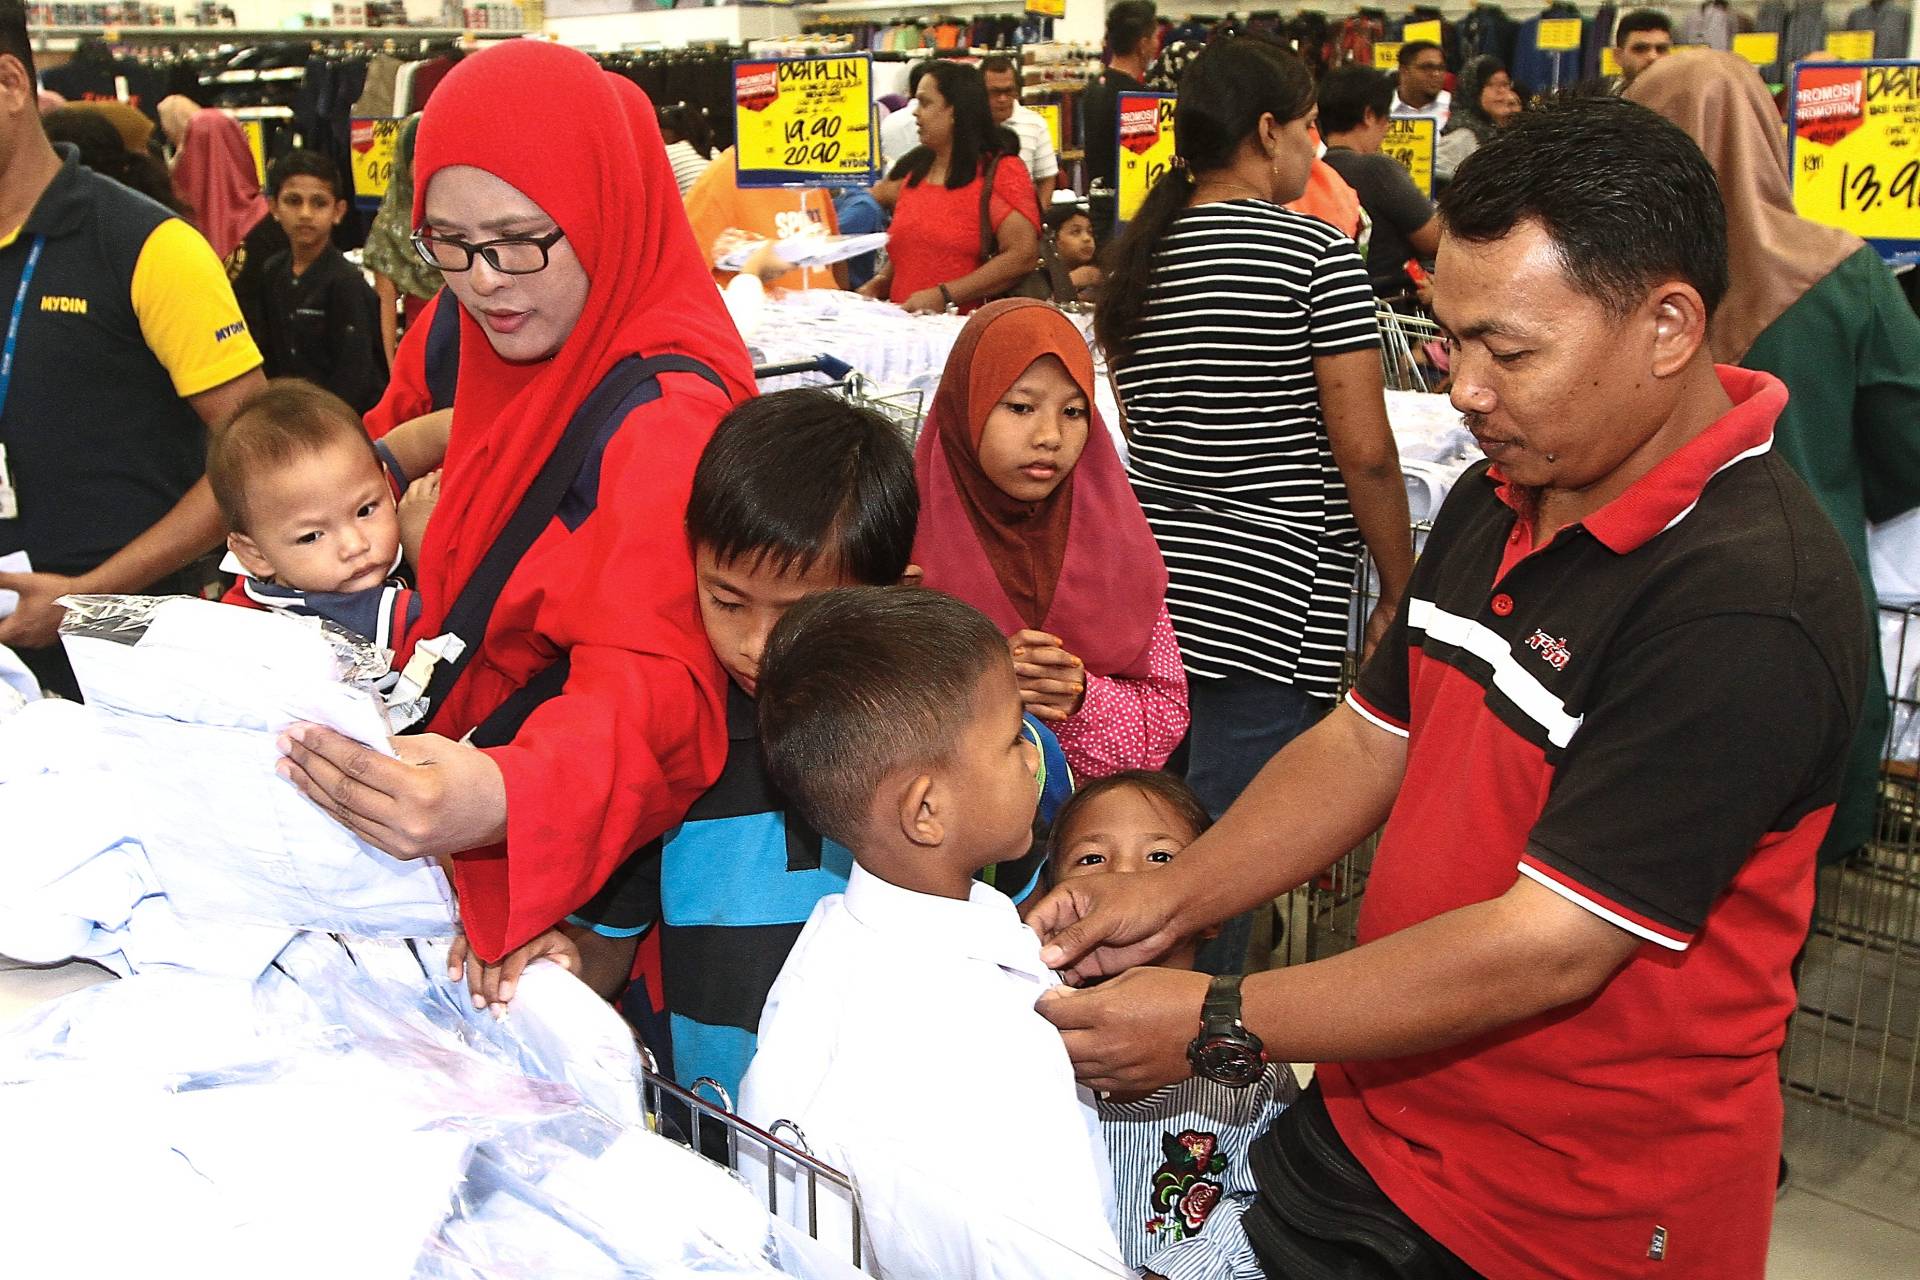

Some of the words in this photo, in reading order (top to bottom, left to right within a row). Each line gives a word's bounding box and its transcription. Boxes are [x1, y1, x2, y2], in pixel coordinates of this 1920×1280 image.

[784, 115, 842, 144] 19.90
[783, 140, 841, 166] 20.90
[1840, 158, 1920, 213] 13.9
[40, 295, 88, 314] MYDIN
